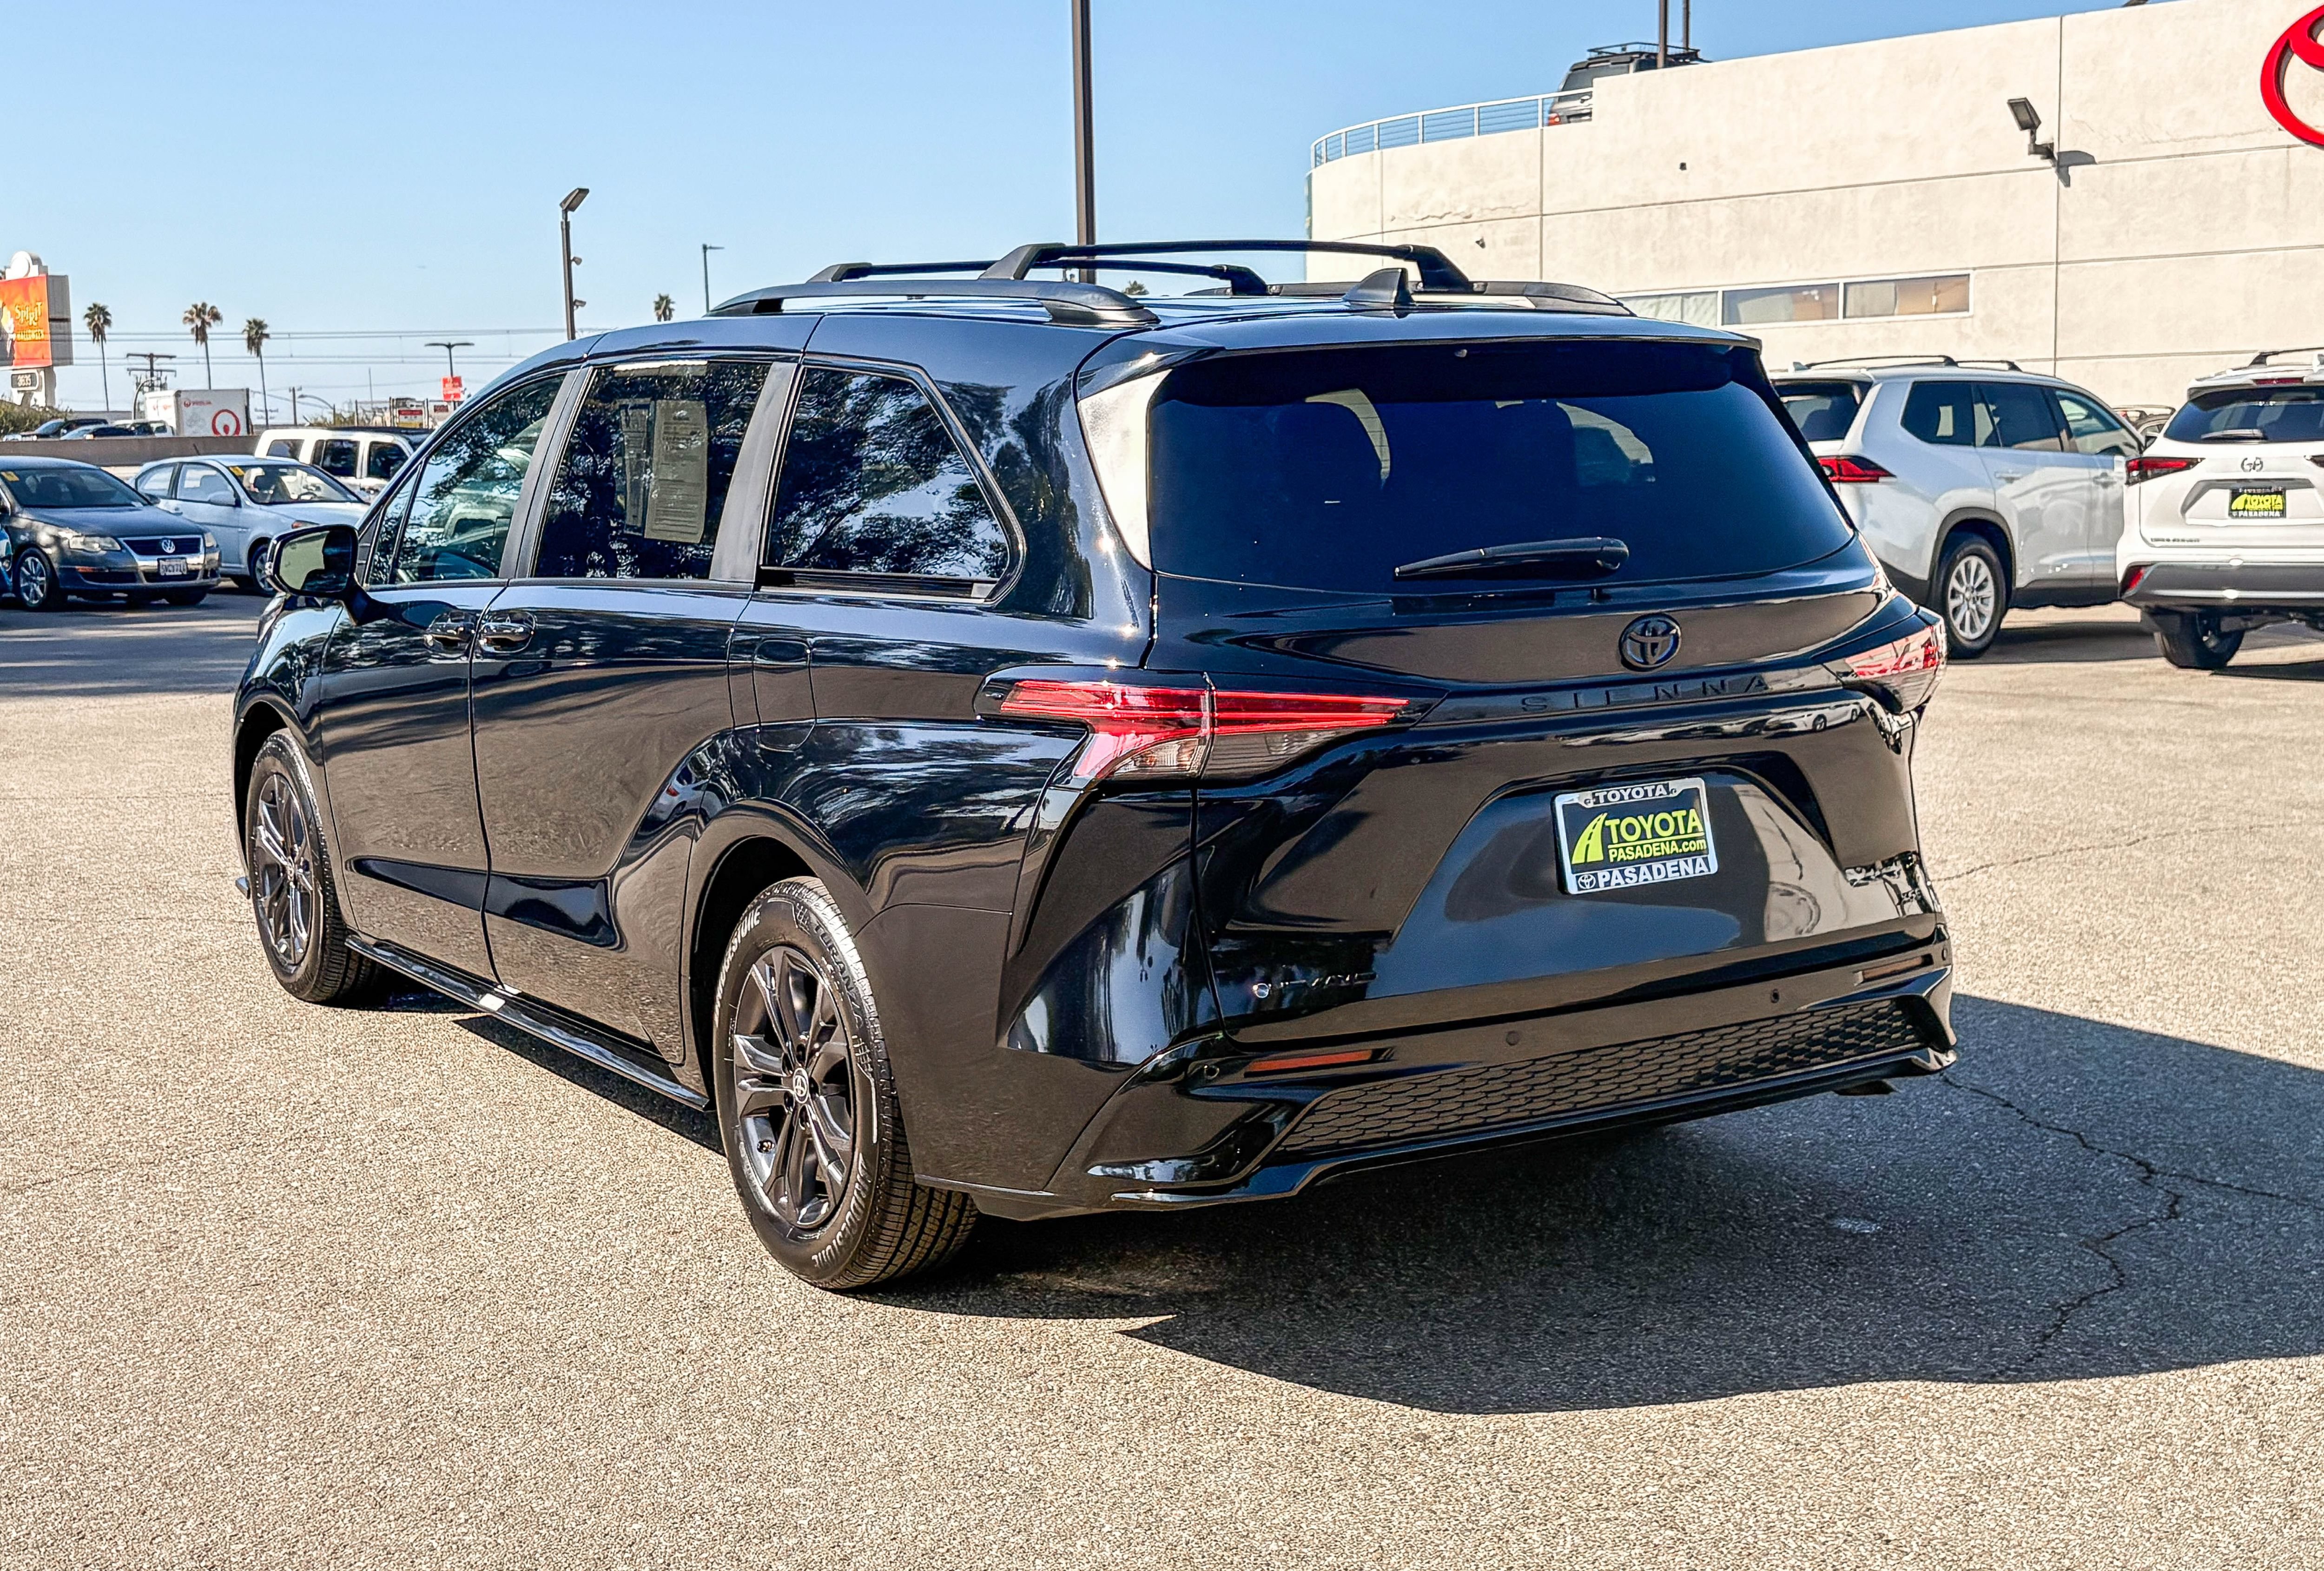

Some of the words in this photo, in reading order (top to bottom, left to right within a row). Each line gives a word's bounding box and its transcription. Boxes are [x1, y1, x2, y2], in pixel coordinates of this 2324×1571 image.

[1521, 675, 1768, 712] SIENNA
[1595, 785, 1667, 803] TOYOTA
[1604, 809, 1703, 844] TOYOTA
[1608, 838, 1707, 863] PASADENA.com
[1597, 858, 1709, 888] PASADENA
